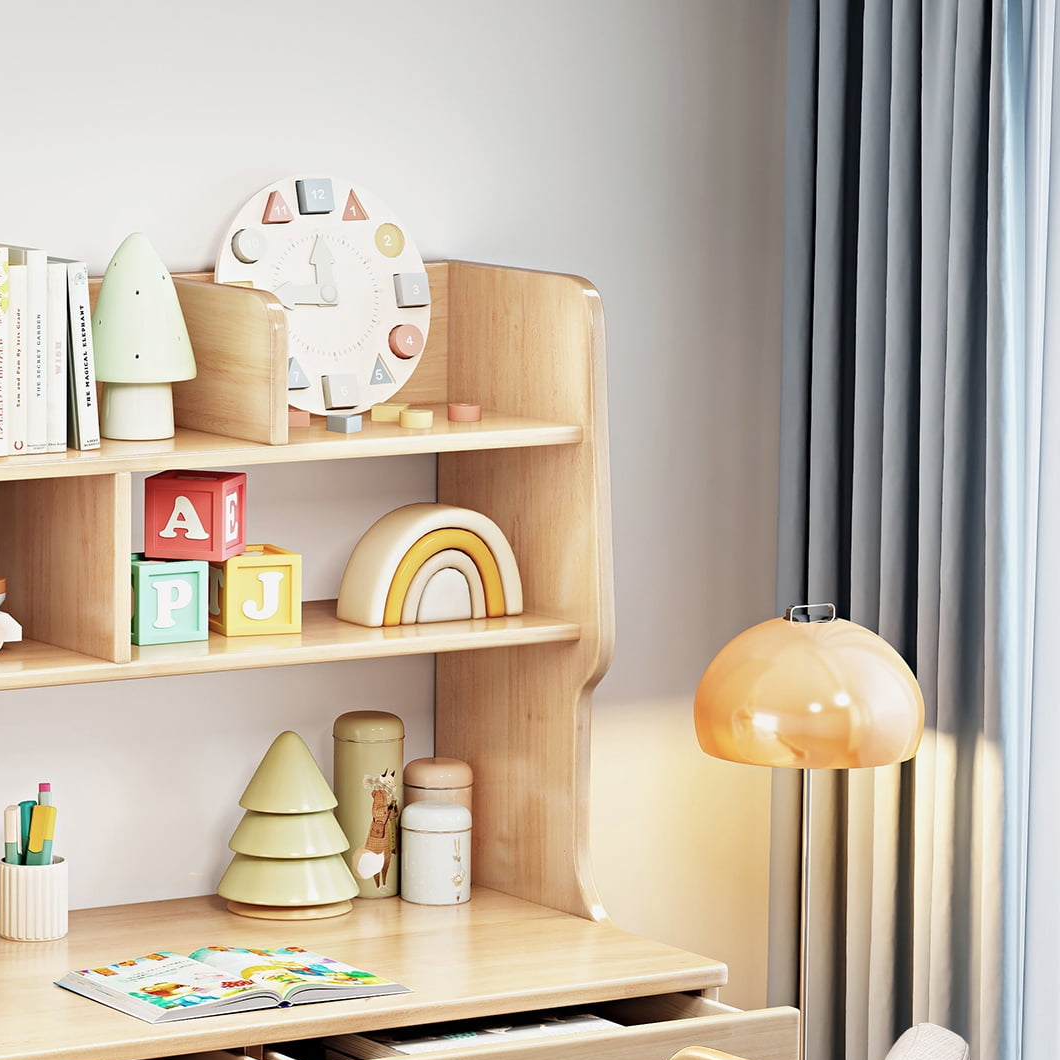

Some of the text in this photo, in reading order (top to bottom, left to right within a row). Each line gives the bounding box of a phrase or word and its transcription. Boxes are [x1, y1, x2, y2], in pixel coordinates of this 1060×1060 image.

[311, 189, 325, 200] 12
[273, 204, 287, 216] 11
[350, 206, 356, 217] 1
[383, 235, 392, 247] 2
[412, 284, 420, 295] 3
[405, 335, 414, 346] 4
[293, 372, 300, 383] 7
[375, 369, 383, 381] 5
[158, 495, 210, 540] A
[225, 491, 238, 543] E
[242, 571, 284, 621] J
[151, 579, 193, 629] P
